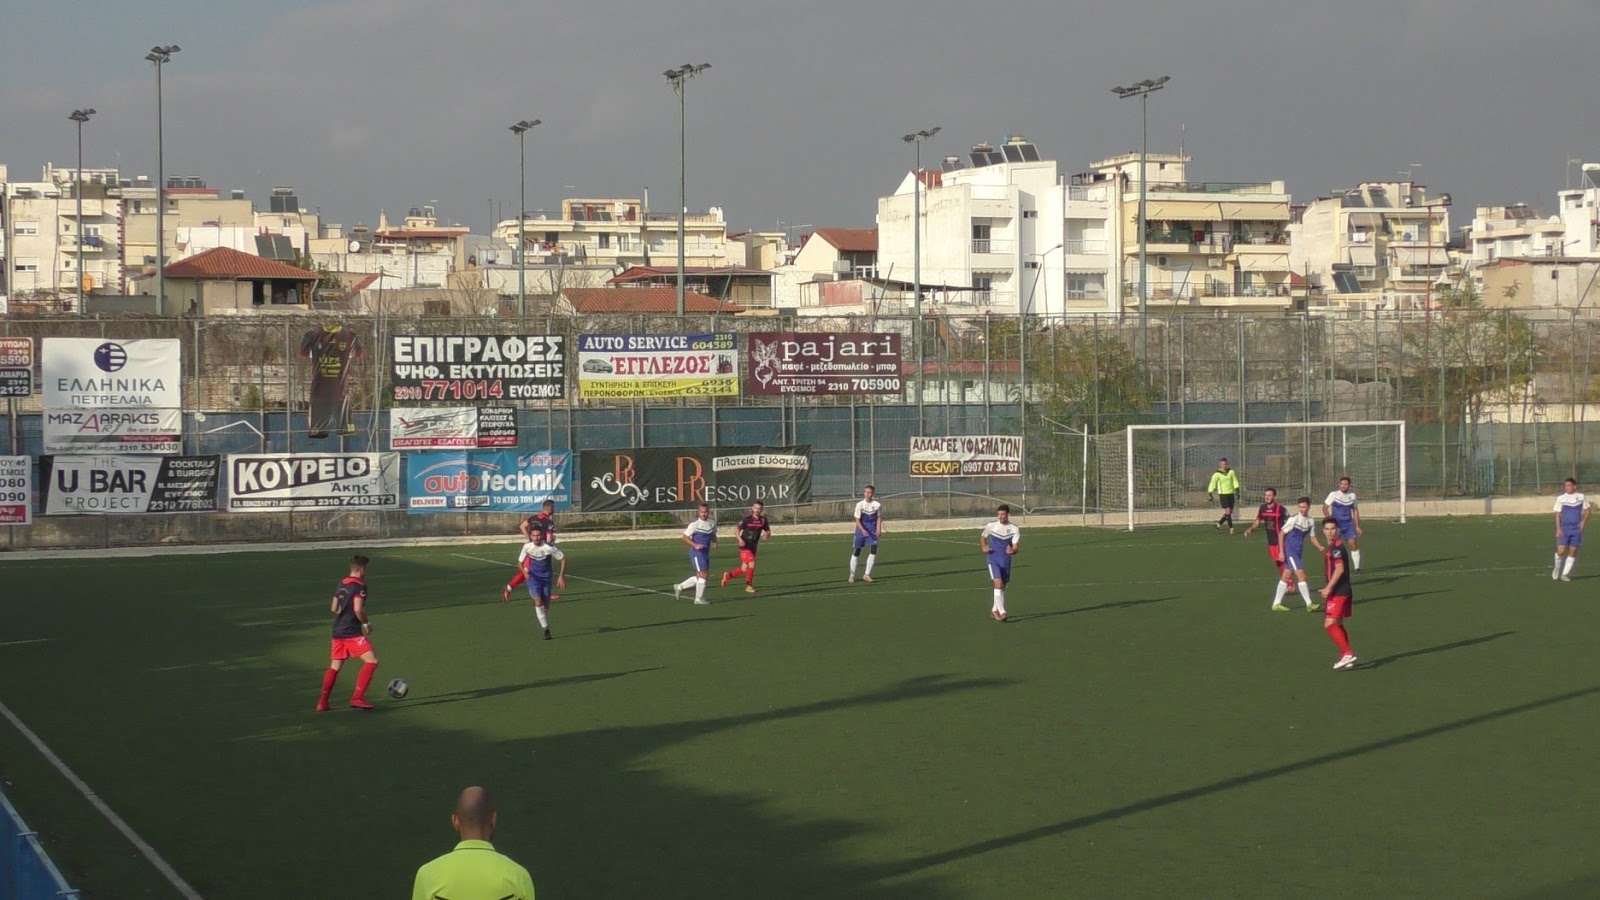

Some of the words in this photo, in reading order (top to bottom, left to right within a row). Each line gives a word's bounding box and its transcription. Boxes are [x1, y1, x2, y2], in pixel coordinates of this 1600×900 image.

[394, 336, 563, 363] ΕΠΙΓΡΑΦΕΣ
[584, 337, 624, 350] AUTO
[628, 336, 688, 349] SERVICE
[781, 335, 897, 362] pajari
[395, 365, 445, 379] ΨΗΦ.
[449, 363, 563, 379] ΕΚΤΥΠΩΣΕΙΣ
[782, 362, 804, 372] καφέ
[811, 362, 869, 373] μεζεδοπωλείο
[876, 363, 897, 372] μπαρ
[57, 378, 166, 392] ΕΛΛΗΝΙΚΑ
[421, 379, 504, 400] 771014
[509, 384, 562, 398] ΕΥΟΣΜΟΣ
[591, 381, 633, 389] ΣΥΝΤΗΡΗΣΗ
[643, 380, 677, 388] ΕΠΙΣΚΕΥΗ
[828, 383, 849, 391] 2310
[851, 378, 900, 391] 705900
[584, 389, 644, 397] ΠΕΡΟΝΟΦΟΡΩΝ
[71, 395, 153, 405] ΠΕΤΡΕΛΑΙΑ
[912, 438, 958, 453] ΑΛΛΑΓΕΣ
[960, 438, 1021, 459] ΥΦΑΣΜΑΤΩΝ
[92, 457, 117, 468] THE
[716, 457, 756, 468] Πλατεία
[963, 462, 982, 473] 6907
[984, 462, 994, 472] 07
[996, 462, 1007, 472] 34
[1008, 462, 1019, 472] 07
[57, 469, 79, 493] U
[90, 469, 147, 494] BAR
[238, 458, 367, 493] ΚΟΥΡΕΙΟ
[331, 481, 369, 495] Άκης
[756, 484, 790, 500] BAR
[64, 496, 141, 509] PROJECT
[150, 500, 176, 511] 2310
[318, 498, 340, 506] 2310
[341, 495, 394, 505] 740573
[411, 498, 444, 506] DELIVERY
